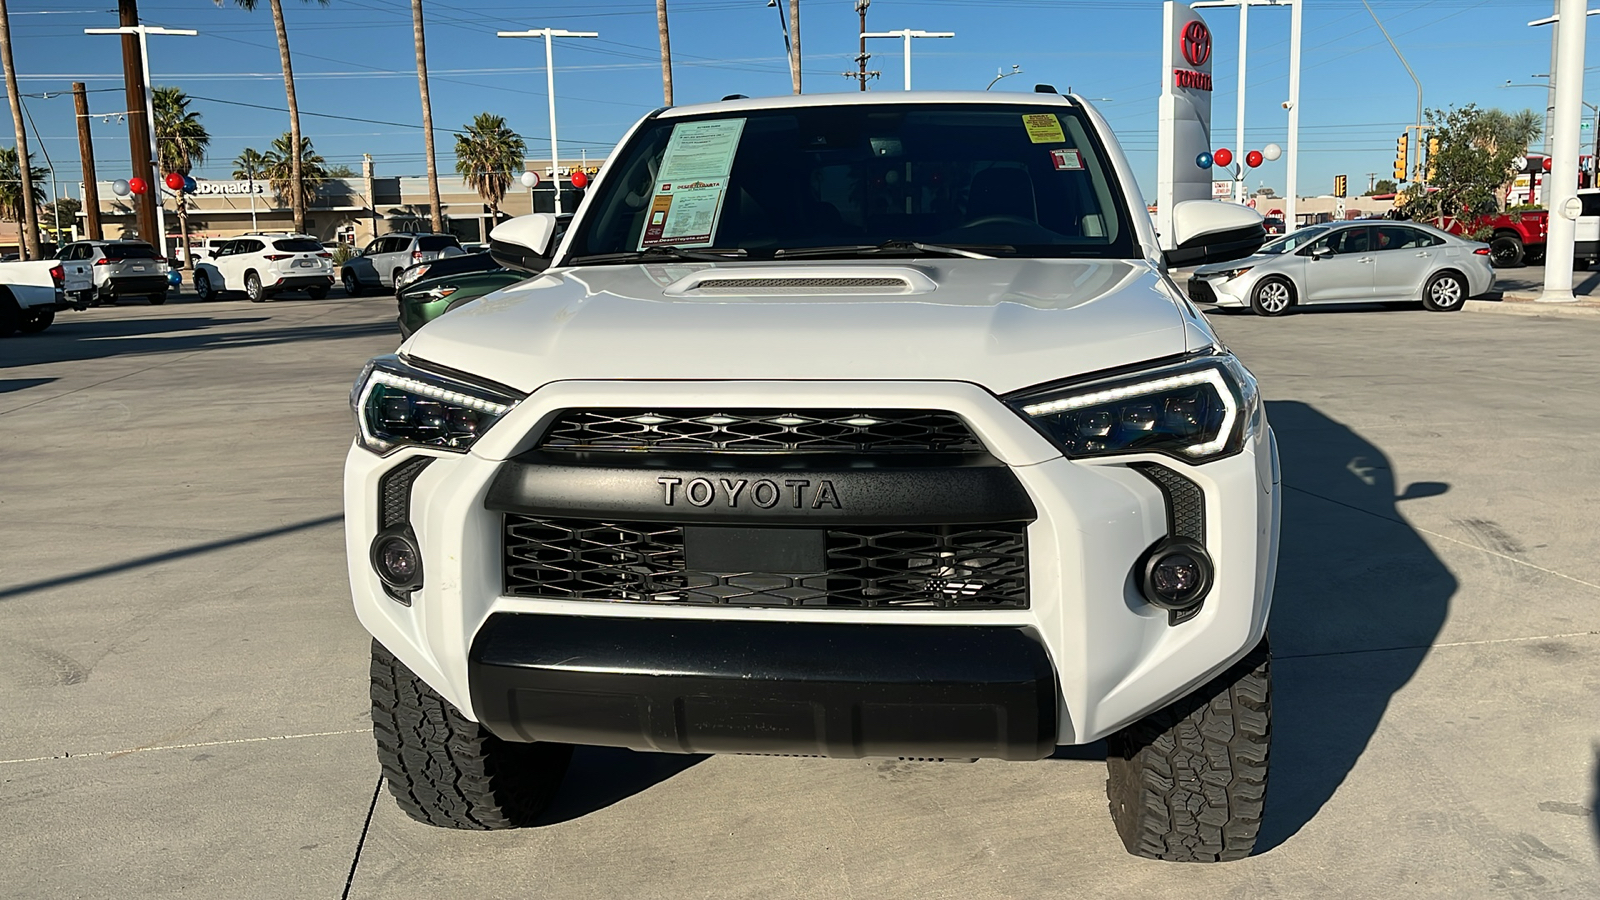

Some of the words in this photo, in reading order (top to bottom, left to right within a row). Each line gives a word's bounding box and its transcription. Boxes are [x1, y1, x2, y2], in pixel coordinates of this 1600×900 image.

[1173, 69, 1213, 91] TOYOTA
[193, 182, 261, 194] cDonalds
[658, 477, 842, 509] TOYOTA
